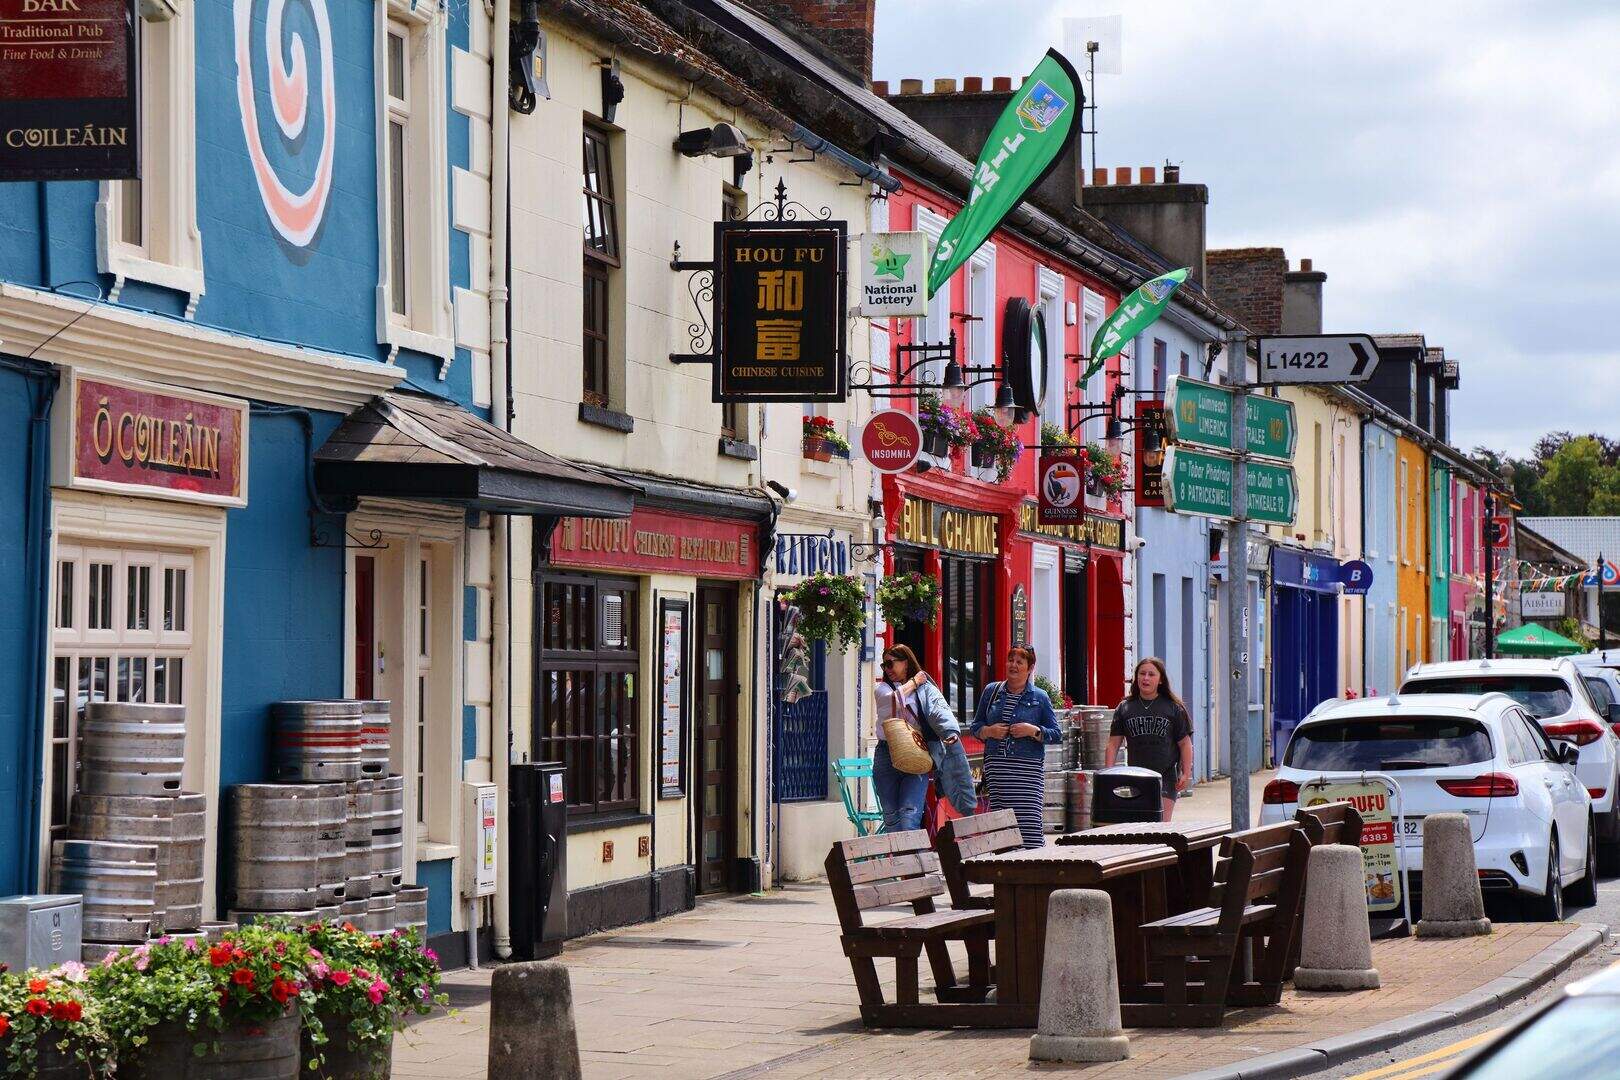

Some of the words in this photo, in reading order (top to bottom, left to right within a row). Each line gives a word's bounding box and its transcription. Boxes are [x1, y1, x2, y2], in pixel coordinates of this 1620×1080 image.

[1, 26, 73, 38] Traditional
[78, 25, 103, 37] Pub
[3, 49, 27, 60] Fine
[30, 49, 54, 60] Food
[57, 48, 67, 59] &
[70, 48, 103, 59] Drink
[6, 124, 128, 148] COILEÁIN
[735, 248, 784, 263] HOU
[794, 248, 825, 263] FU
[865, 285, 917, 295] National
[868, 295, 914, 306] Lottery
[1266, 351, 1329, 369] L1422
[732, 367, 777, 377] CHINESE
[781, 367, 824, 377] CUISINE
[1180, 400, 1197, 424] N21
[93, 396, 113, 458] Ó
[117, 412, 221, 473] COILEÁIN
[1199, 416, 1228, 438] LIMERICK
[871, 449, 912, 459] INSOMNIA
[1180, 482, 1185, 501] 8
[1187, 484, 1231, 507] PATRICKSWELL
[1247, 493, 1277, 512] ATHKEALE
[903, 498, 939, 546] BILL
[944, 510, 999, 555] CHAWKE
[580, 517, 632, 553] HOUFU
[633, 530, 676, 559] CHINESE
[679, 536, 738, 564] RESTAURANT
[1351, 569, 1362, 581] B
[1337, 794, 1385, 813] OUFU
